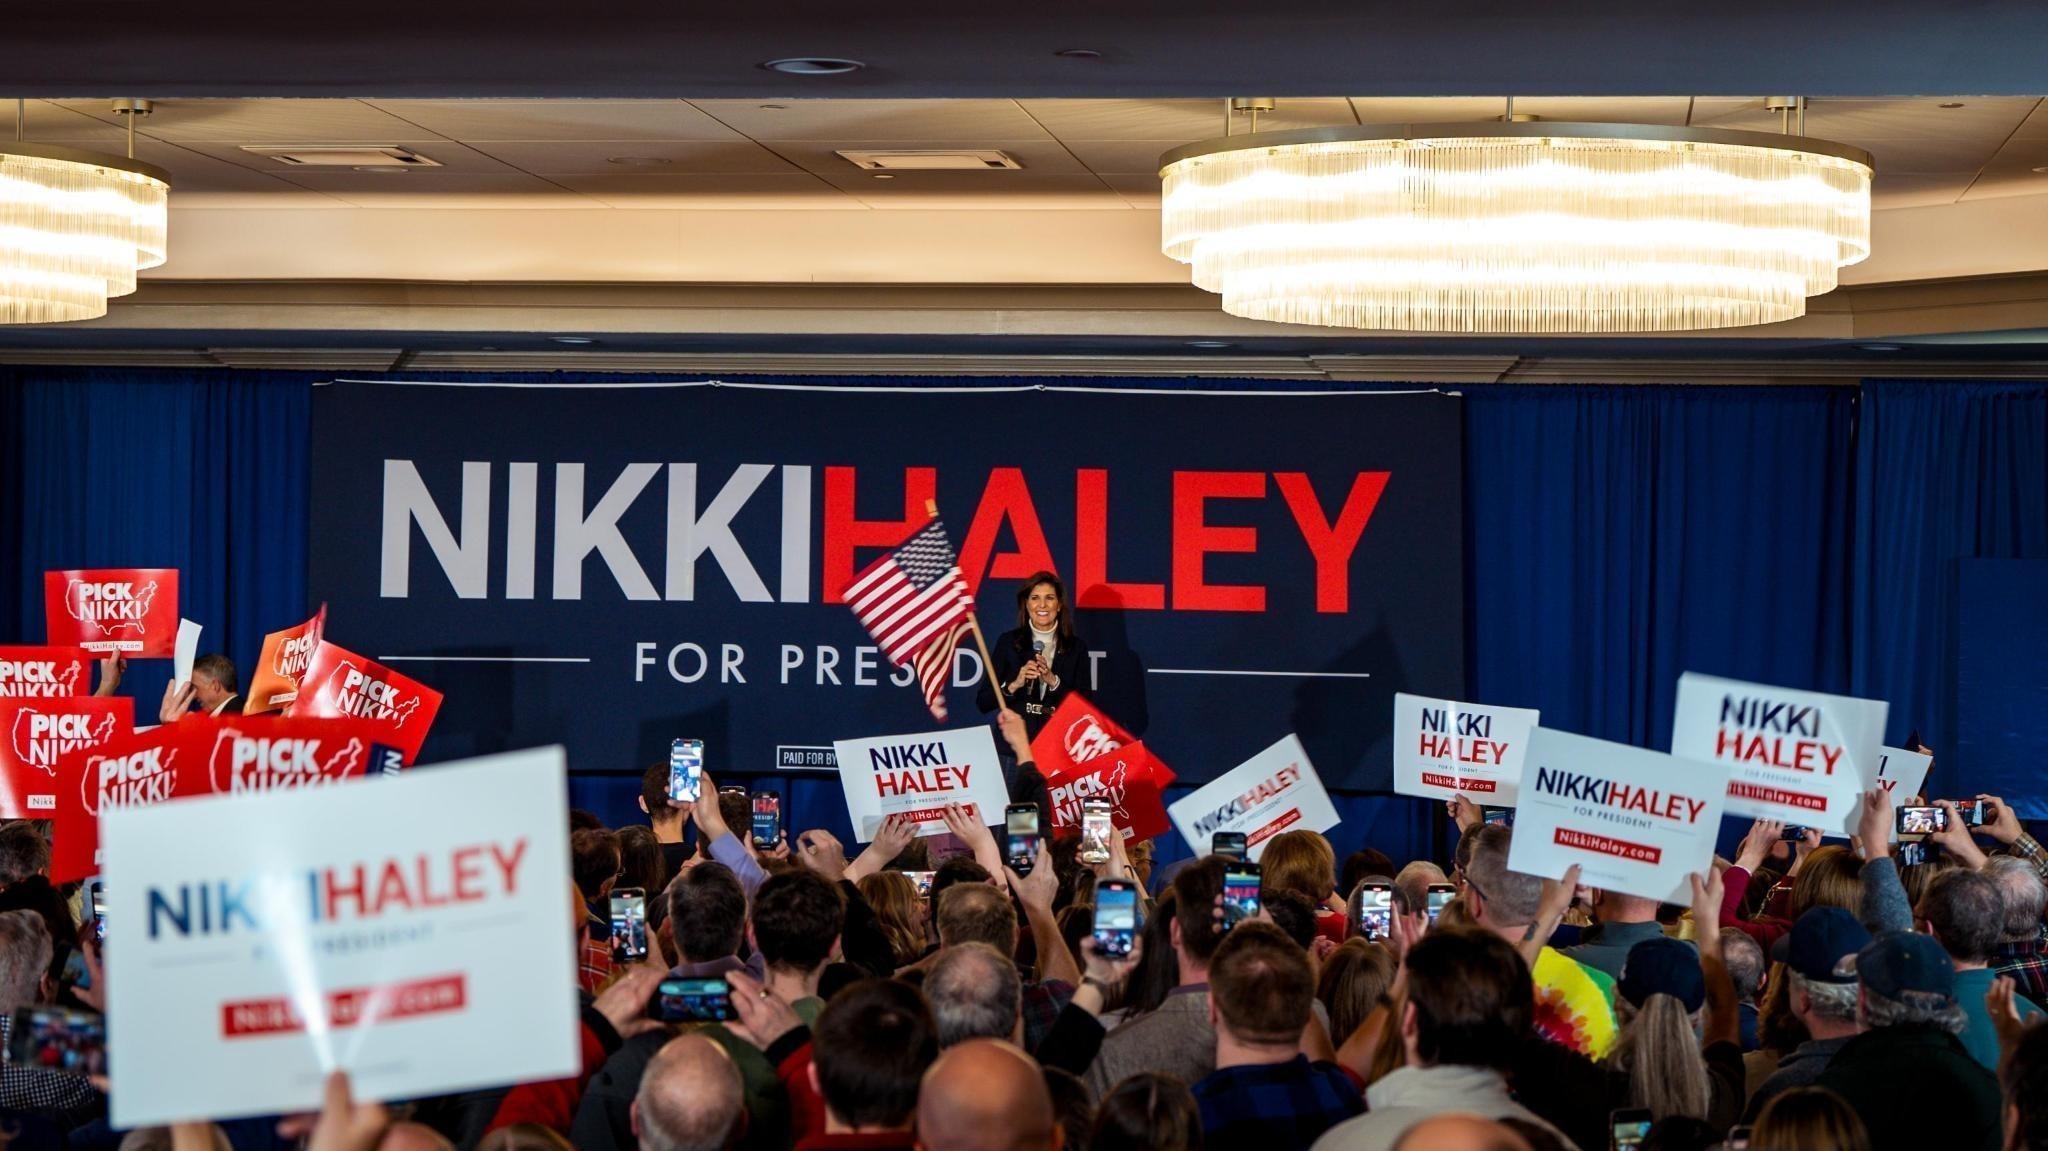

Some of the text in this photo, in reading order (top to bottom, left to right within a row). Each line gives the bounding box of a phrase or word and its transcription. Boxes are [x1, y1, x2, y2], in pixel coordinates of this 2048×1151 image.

[79, 583, 133, 601] PICK
[79, 600, 141, 620] NIKKI
[0, 661, 56, 683] PICK
[635, 643, 1107, 691] FOR PRESDT
[344, 669, 400, 708] PICK
[30, 714, 92, 739] PICK
[1720, 694, 1822, 738] NIKKI
[99, 747, 162, 787] PICK
[232, 738, 321, 773] PICK
[783, 751, 838, 766] PAID FOR BY
[868, 741, 948, 771] NIKKI
[1716, 727, 1844, 775] HALEY
[875, 765, 971, 798] HALEY
[1051, 771, 1107, 807] PICK
[1574, 805, 1654, 830] FOR PRESIDENT
[1558, 831, 1656, 862] NikkiHaley.com
